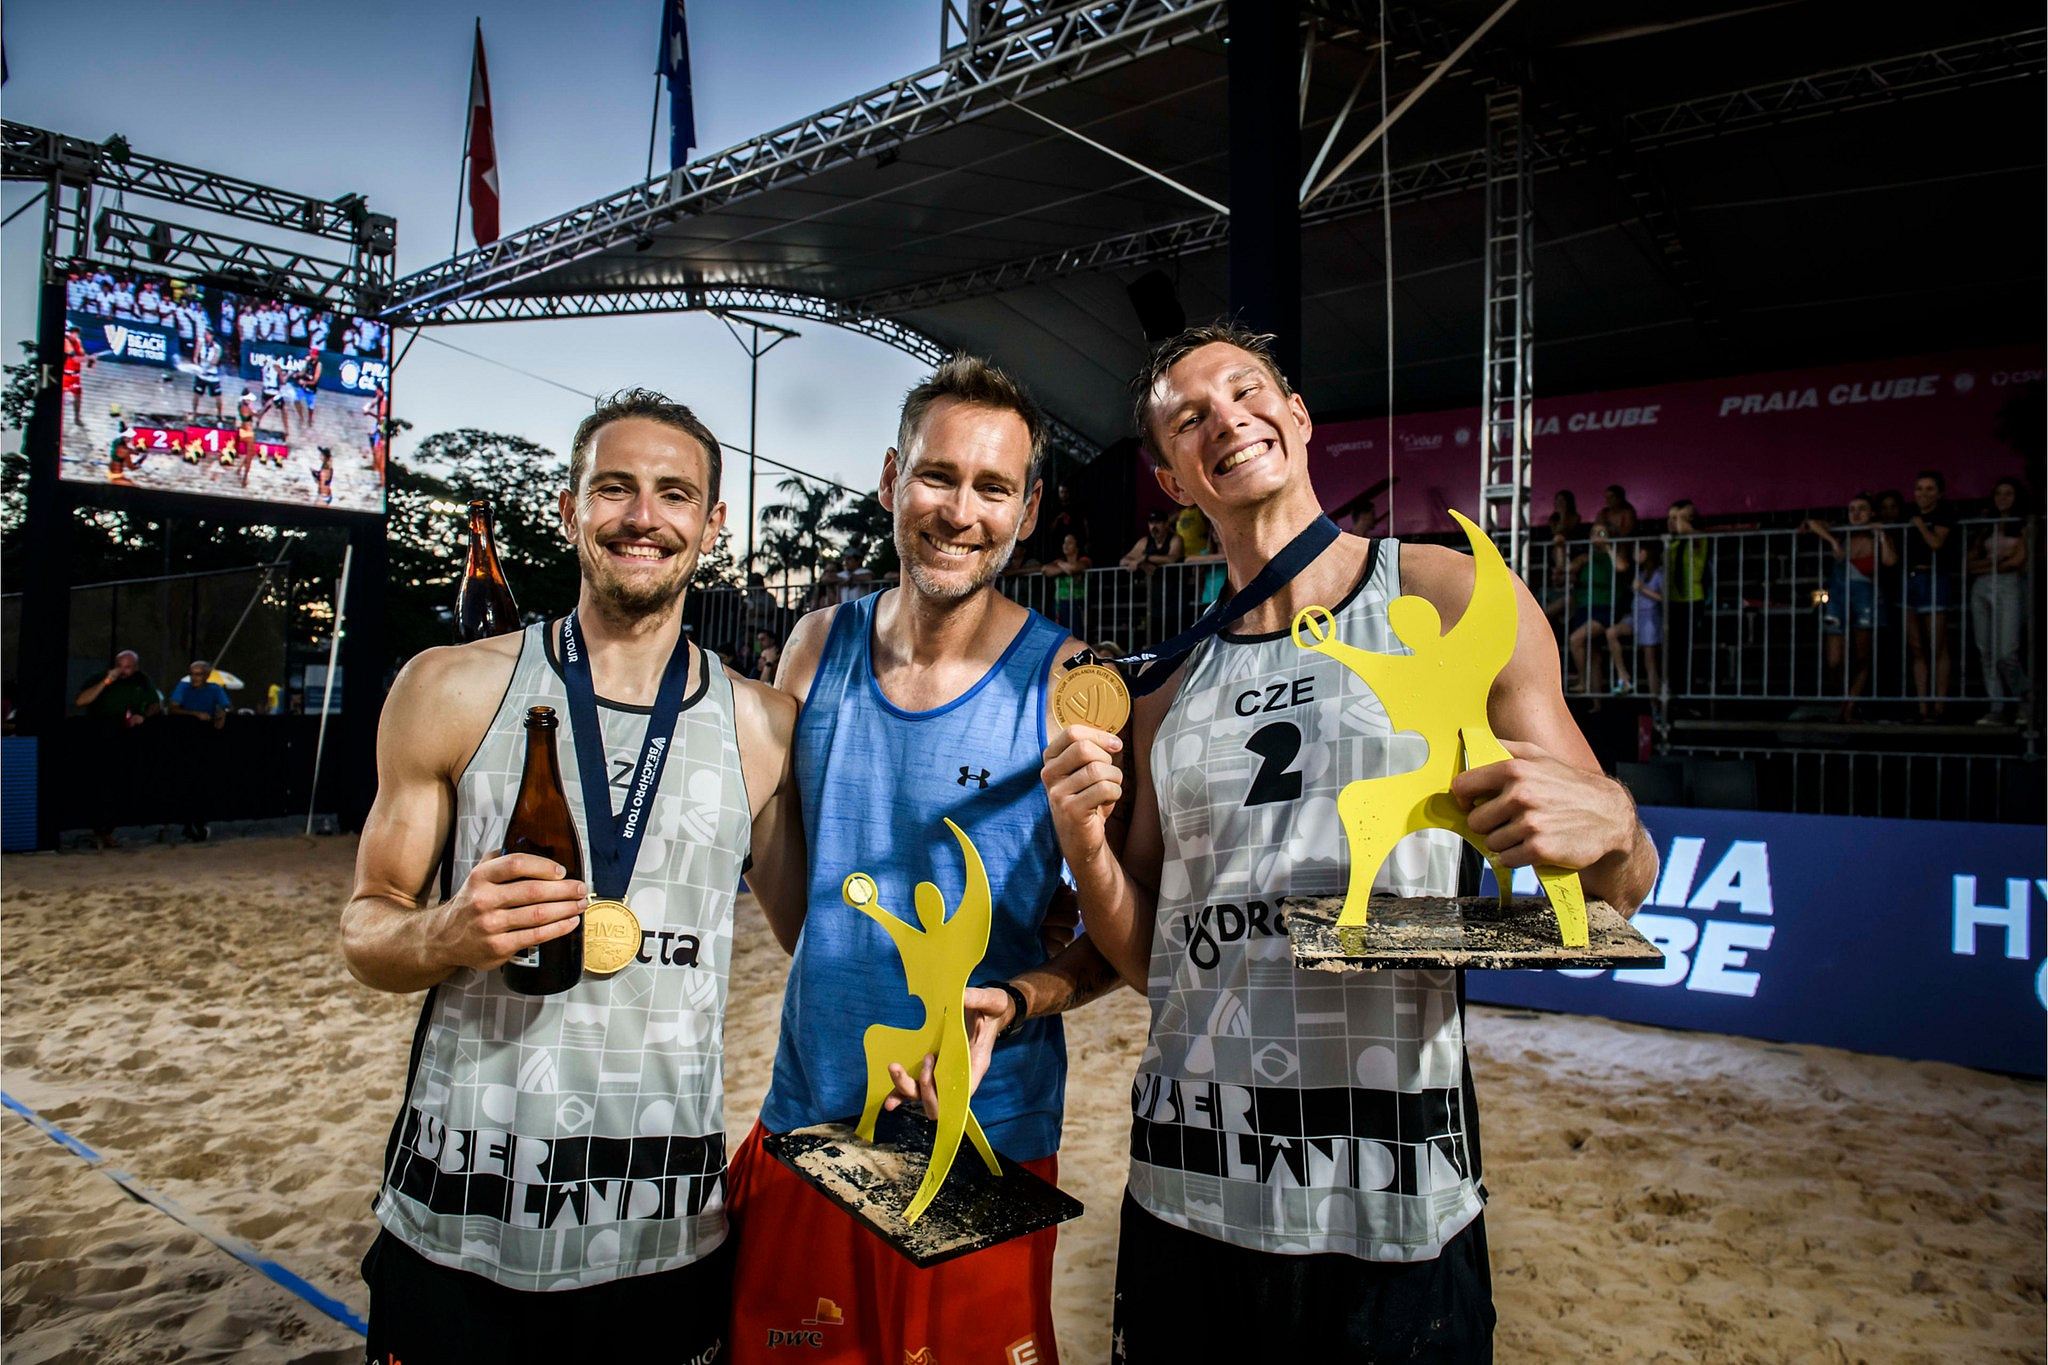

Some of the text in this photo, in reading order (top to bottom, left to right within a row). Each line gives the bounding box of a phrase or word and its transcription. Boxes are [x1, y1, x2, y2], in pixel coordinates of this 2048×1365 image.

[1719, 375, 1940, 417] PRAIA CLUBE
[1567, 405, 1661, 432] CLUBE
[152, 430, 169, 448] 2
[204, 429, 220, 452] 1
[565, 636, 579, 663] TOUR
[1234, 675, 1316, 718] CZE
[1242, 720, 1303, 808] 2
[623, 807, 641, 839] TOUR
[1135, 1073, 1256, 1134] UBER
[417, 1111, 551, 1184] UBER
[767, 1328, 824, 1349] pwc
